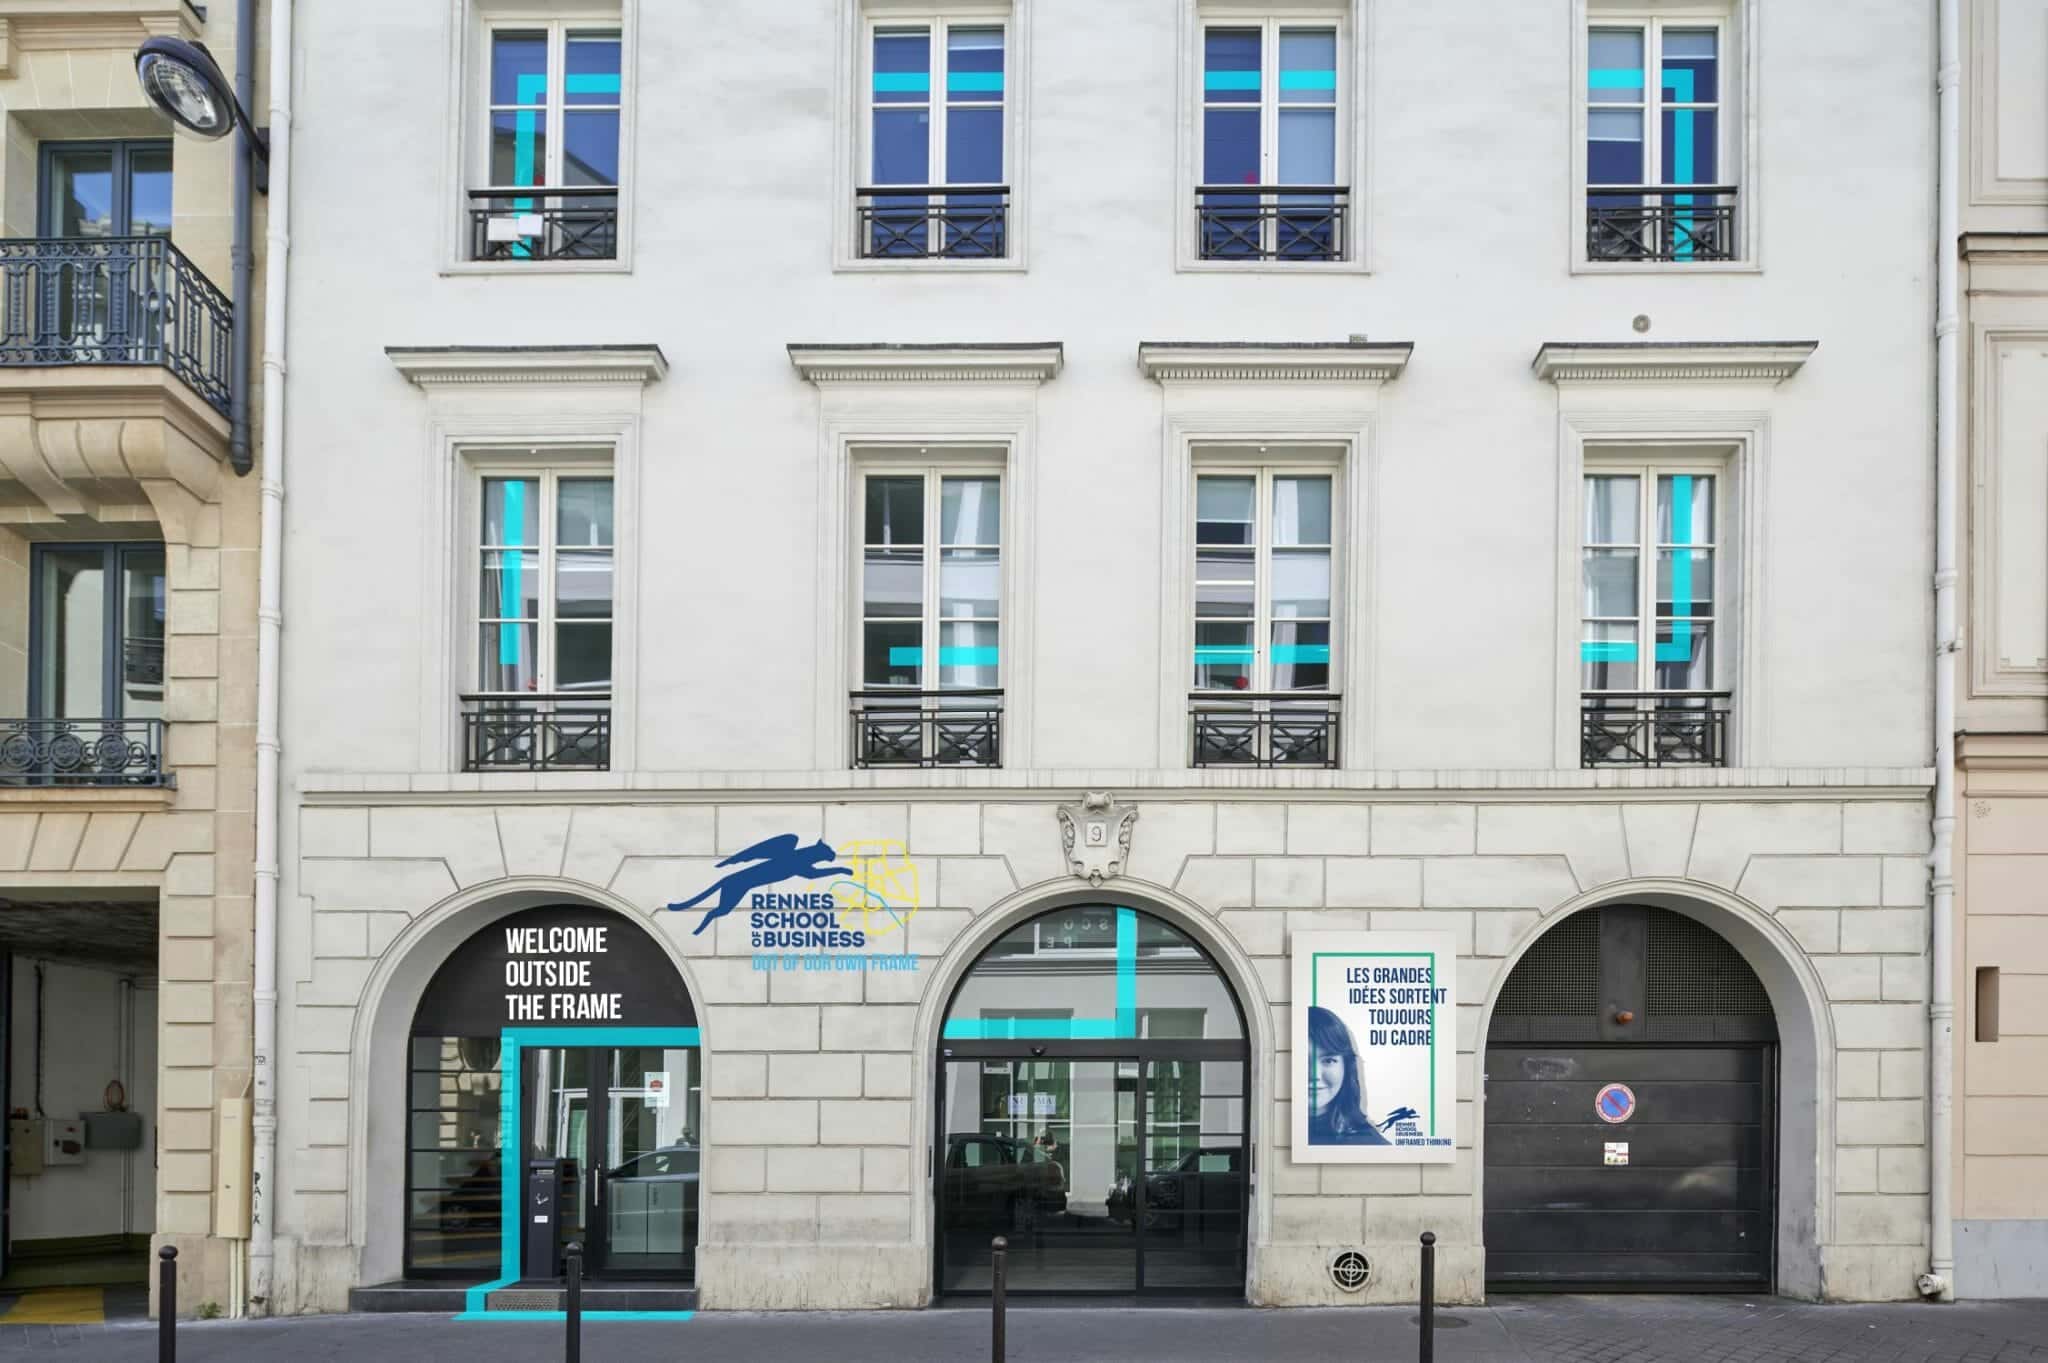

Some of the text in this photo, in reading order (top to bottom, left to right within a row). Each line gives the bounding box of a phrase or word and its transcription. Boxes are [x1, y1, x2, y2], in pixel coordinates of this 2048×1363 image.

[1091, 825, 1102, 842] 9
[751, 893, 834, 910] RENNES
[751, 912, 840, 929] SCHOOL
[505, 927, 608, 953] WELCOME
[751, 931, 865, 948] OF BUSINESS
[752, 953, 920, 971] OUT OF OUR OWN FRAME
[505, 961, 592, 987] OUTSIDE
[1347, 967, 1432, 983] LES GRANDES
[1349, 985, 1447, 1004] IDÉES SORTENT
[505, 993, 622, 1020] THE FRAME
[1369, 1008, 1432, 1025] TOUJOURS
[1370, 1029, 1432, 1045] DU CADRE
